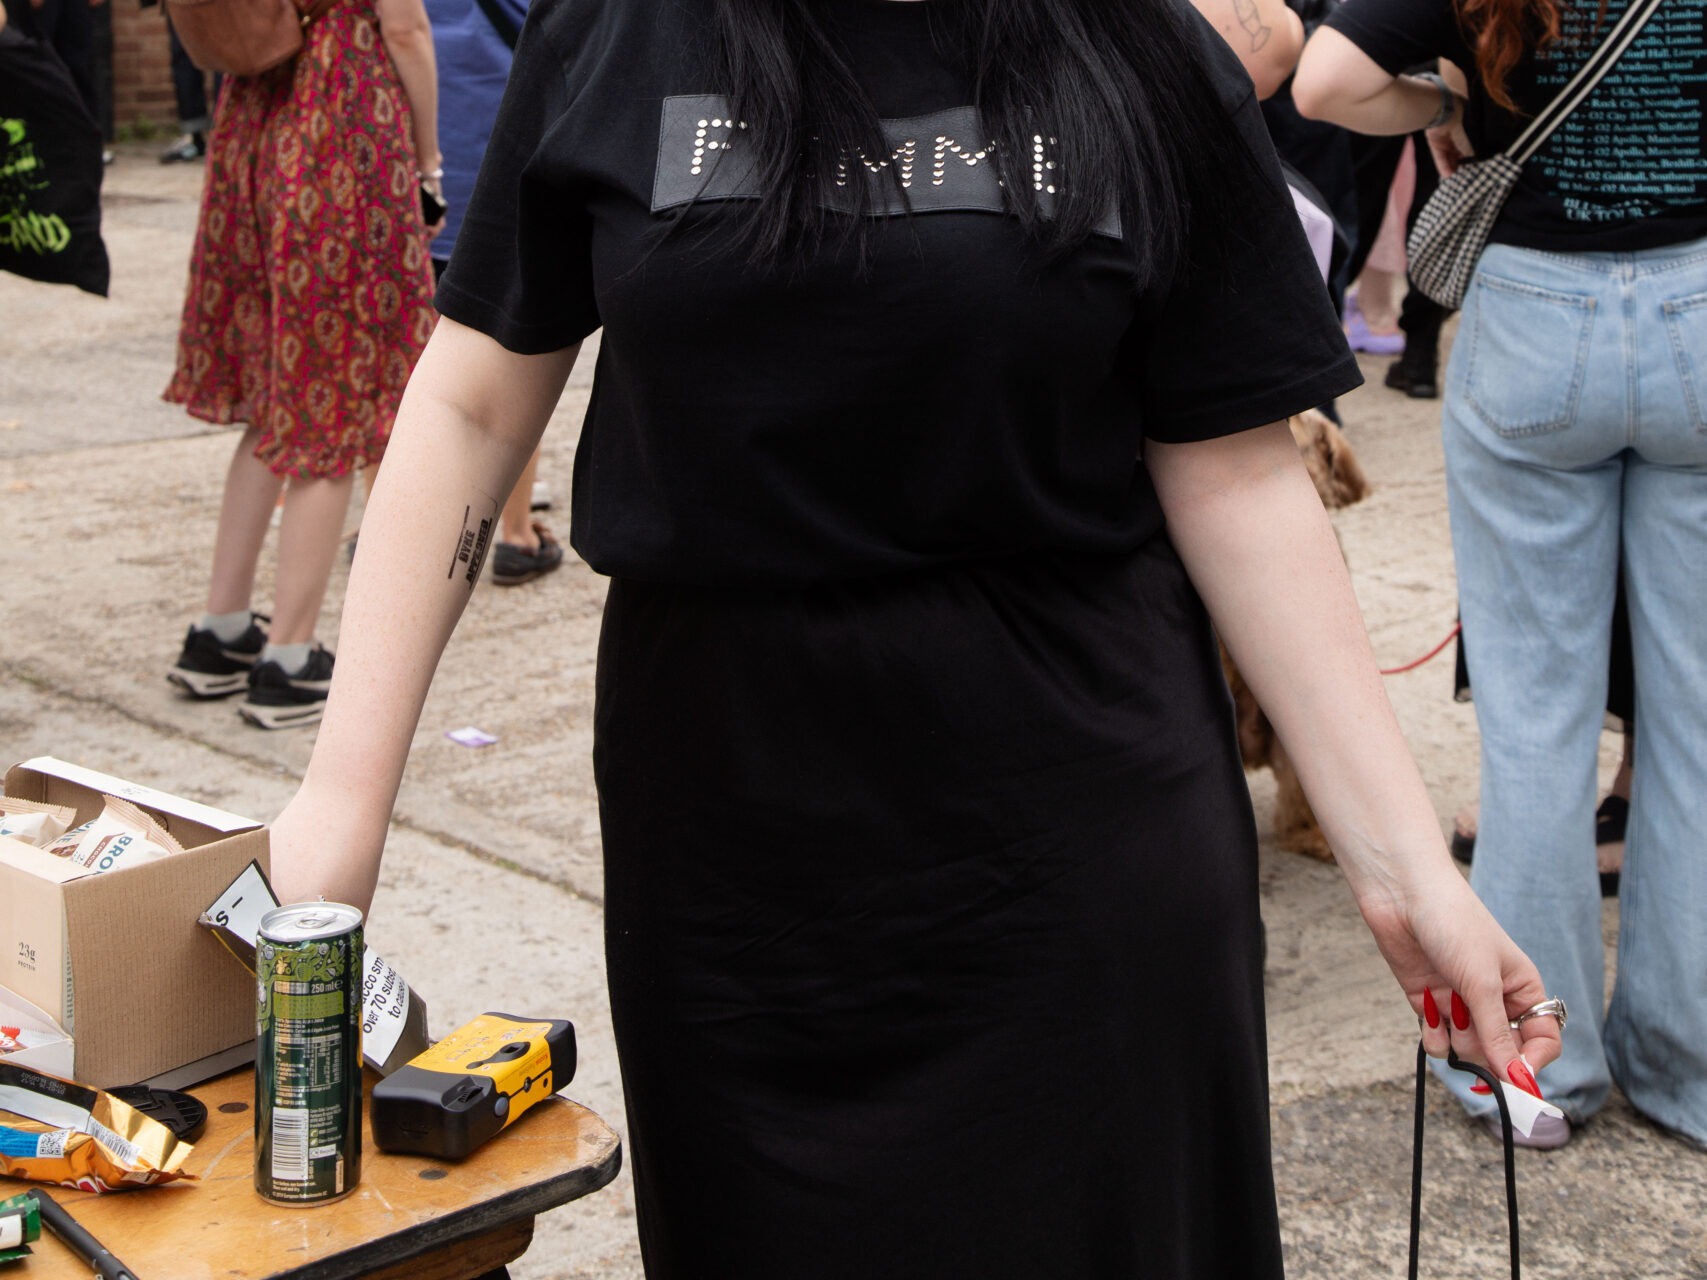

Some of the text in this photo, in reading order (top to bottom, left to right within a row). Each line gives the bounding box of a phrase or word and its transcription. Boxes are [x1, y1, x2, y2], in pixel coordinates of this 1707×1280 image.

[1664, 10, 1703, 19] London
[1664, 23, 1703, 32] London
[1665, 36, 1703, 45] London
[1639, 86, 1680, 95] Norwich
[1590, 99, 1617, 108] Rock
[1644, 98, 1700, 109] Nottingham
[1658, 122, 1699, 131] Sheffield
[1647, 134, 1700, 143] Manchester
[1647, 147, 1700, 156] Manchester
[690, 118, 1064, 196] FMME
[1564, 158, 1578, 168] De
[1663, 184, 1696, 193] Bristol
[95, 835, 133, 874] BRO
[19, 942, 36, 964] 23g
[311, 983, 324, 994] 250
[325, 981, 334, 991] ml
[370, 994, 387, 1011] 70
[388, 1005, 401, 1019] to
